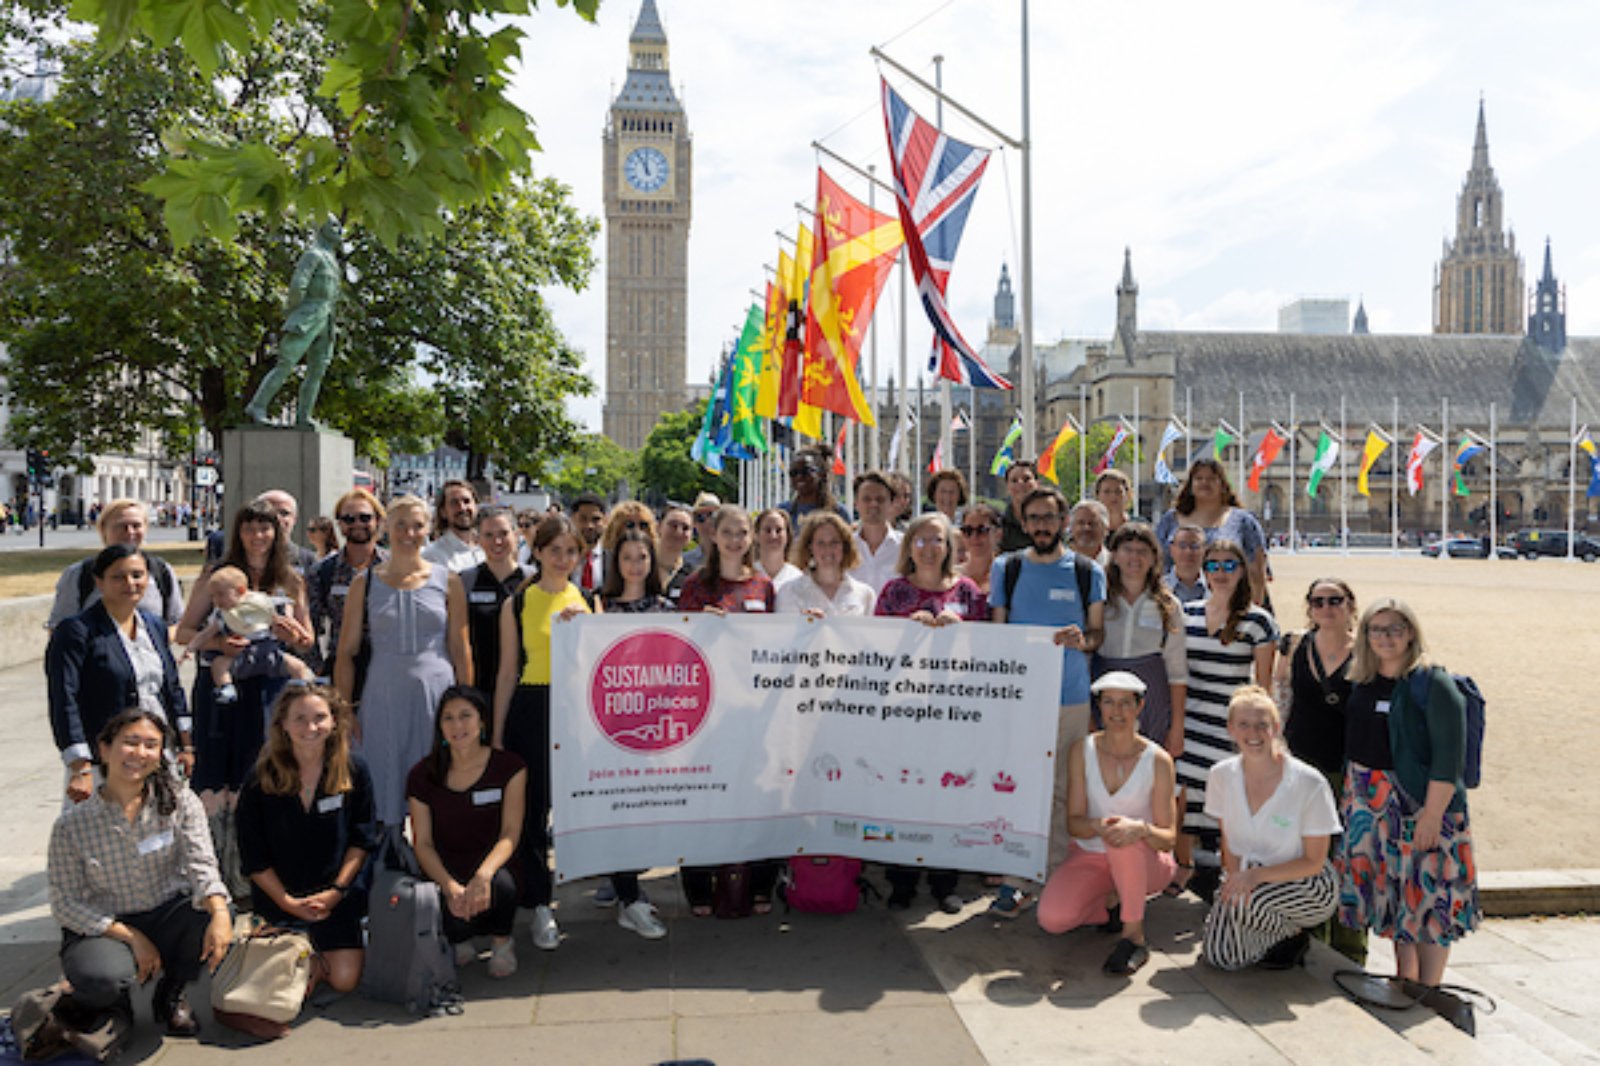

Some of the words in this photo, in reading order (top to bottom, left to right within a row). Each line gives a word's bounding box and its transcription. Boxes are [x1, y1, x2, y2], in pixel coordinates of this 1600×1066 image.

[752, 650, 820, 667] Making
[824, 650, 895, 671] healthy
[900, 655, 913, 668] &
[919, 657, 1028, 675] sustainable
[602, 664, 701, 689] SUSTAINABLE
[753, 674, 795, 689] food
[799, 676, 810, 689] a
[815, 674, 890, 695] defining
[895, 678, 1024, 700] characteristic
[605, 692, 645, 715] FOOD
[647, 694, 699, 714] places
[797, 699, 815, 713] of
[819, 699, 877, 716] where
[882, 704, 943, 722] people
[948, 706, 982, 722] live
[619, 767, 640, 777] the
[645, 765, 712, 777] movement
